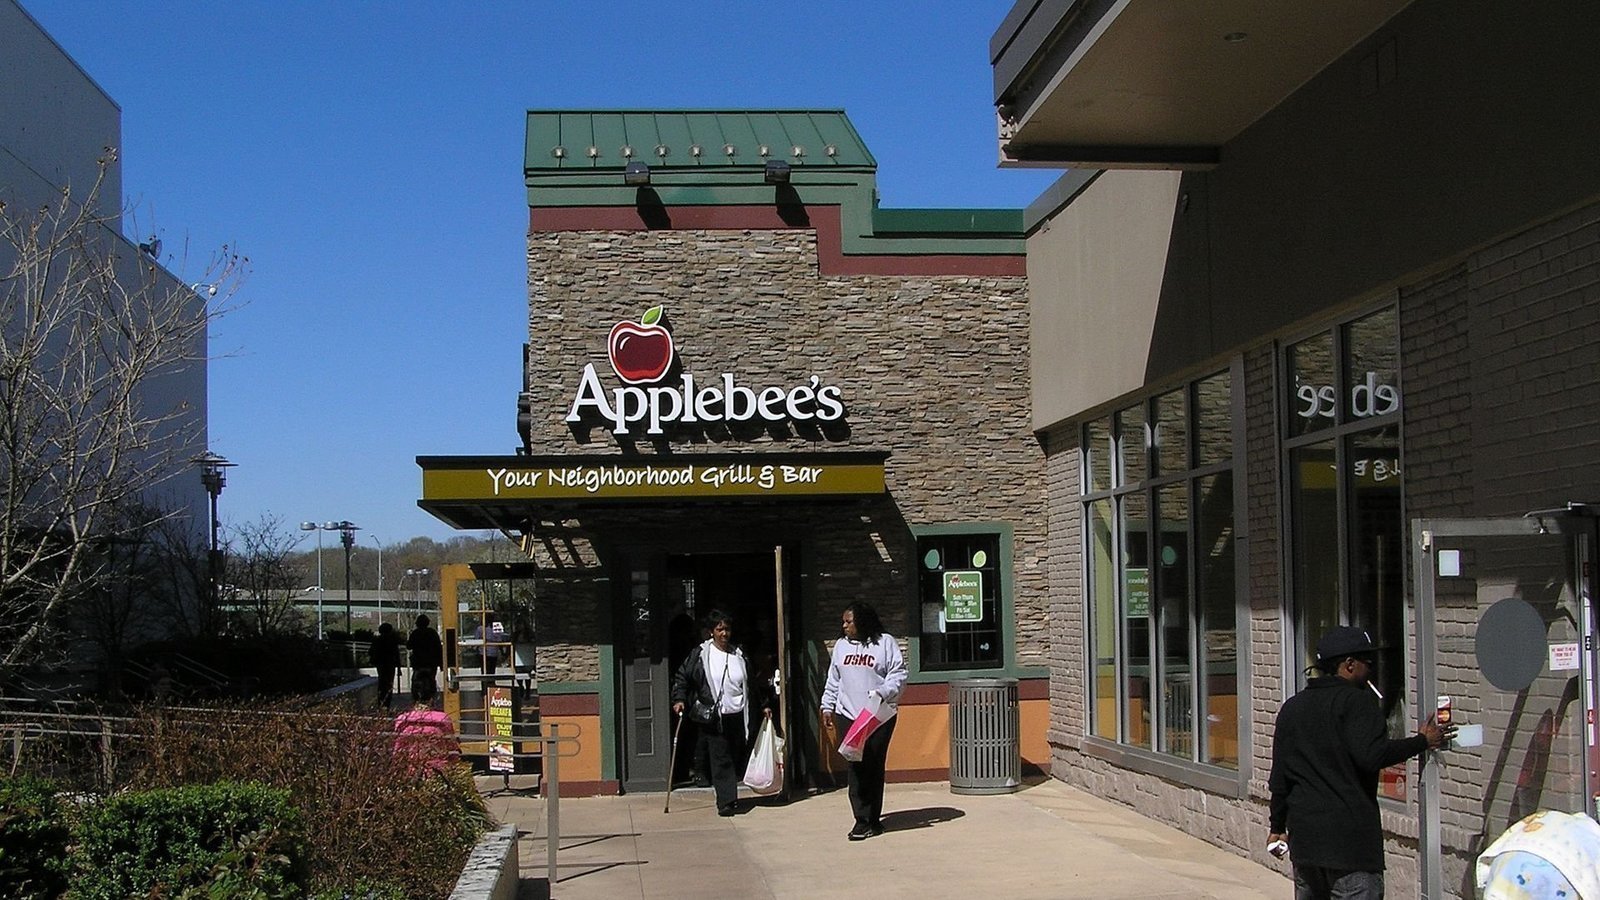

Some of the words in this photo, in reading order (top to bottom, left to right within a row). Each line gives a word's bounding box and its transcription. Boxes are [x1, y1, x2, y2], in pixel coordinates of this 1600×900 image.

[565, 363, 844, 434] Applebee's
[487, 468, 542, 495] Your
[549, 464, 694, 492] Neighborhood
[700, 464, 755, 489] Grill
[758, 465, 775, 489] &
[780, 465, 824, 484] Bar
[843, 654, 875, 668] USMC
